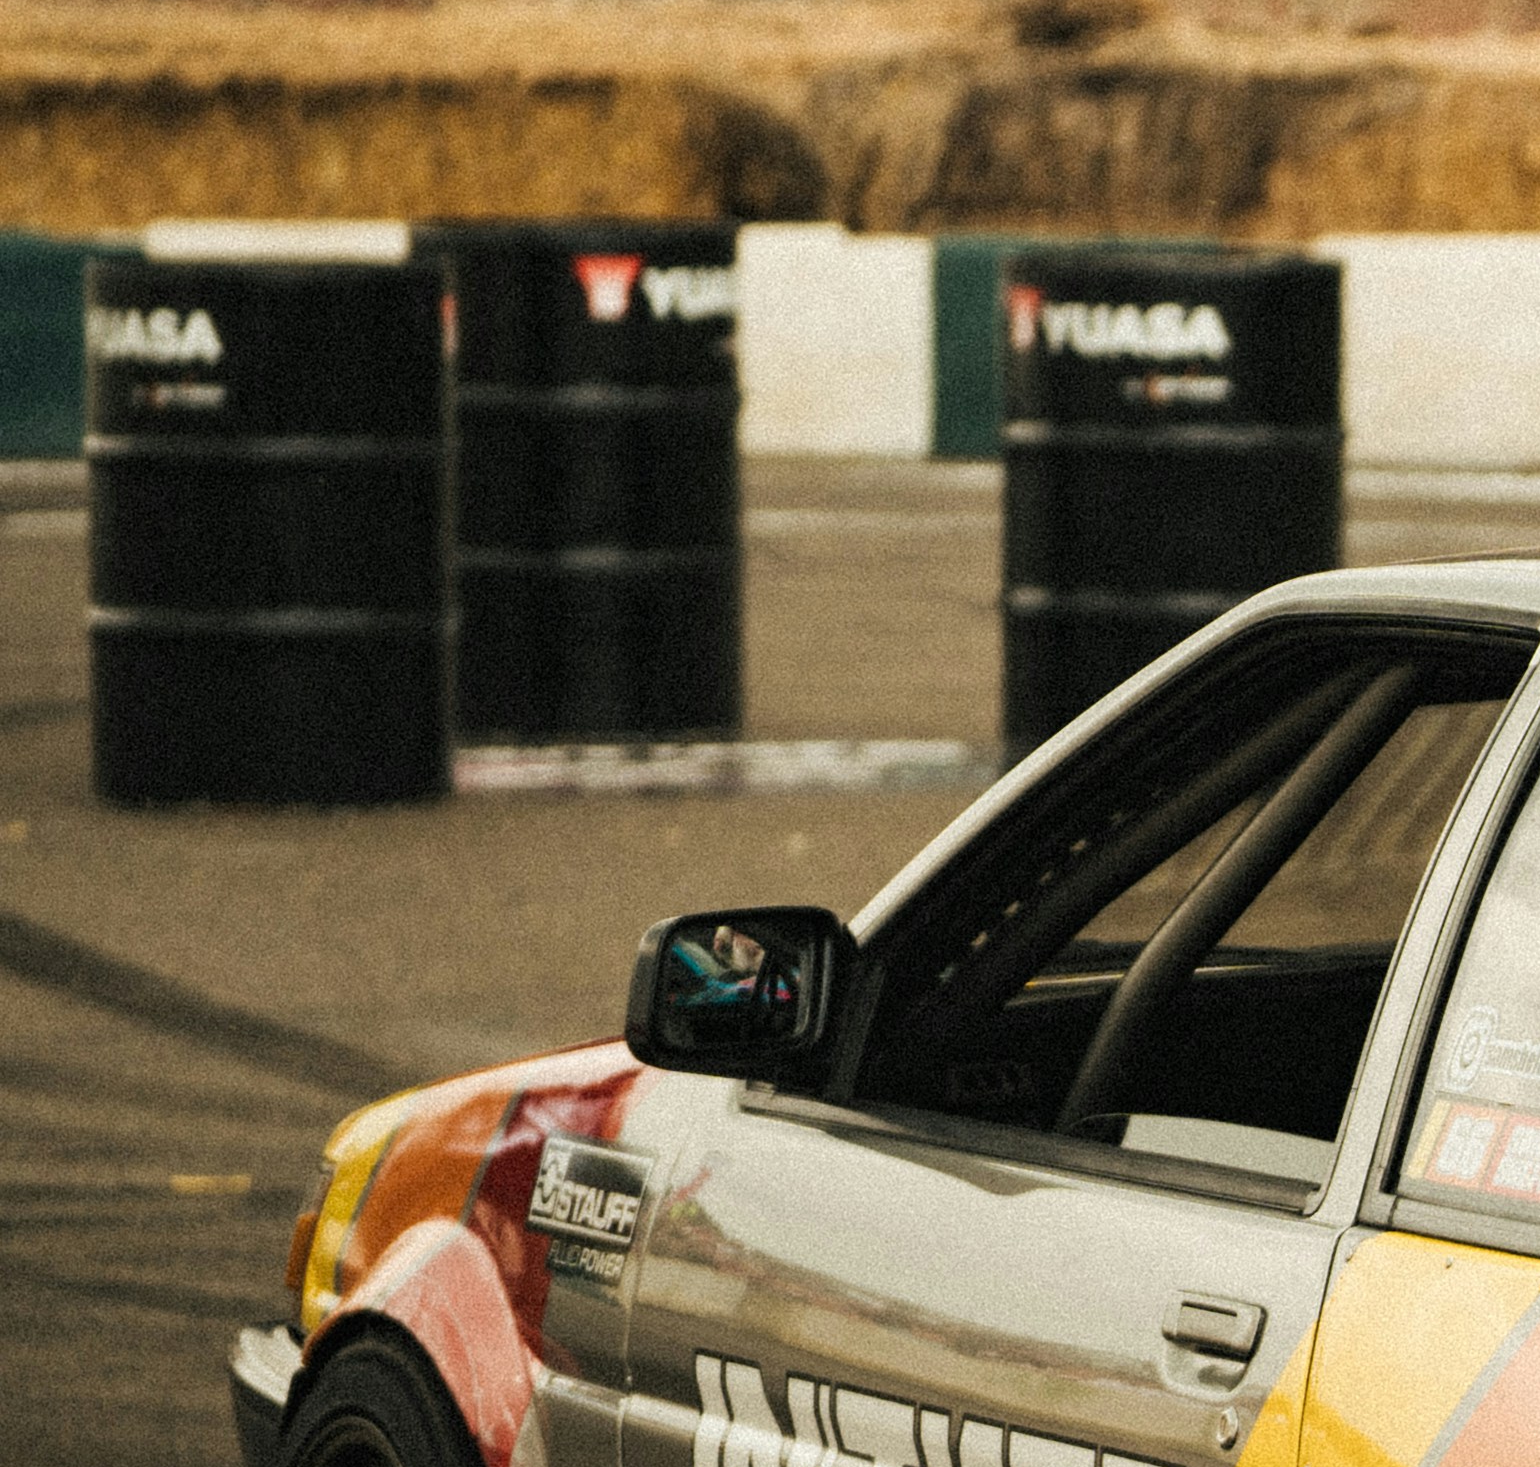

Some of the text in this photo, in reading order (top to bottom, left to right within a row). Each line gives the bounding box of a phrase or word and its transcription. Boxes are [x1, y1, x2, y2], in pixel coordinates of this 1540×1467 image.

[1041, 301, 1234, 361] YUASA
[554, 1179, 640, 1233] STAUFF
[578, 1247, 626, 1280] POWER
